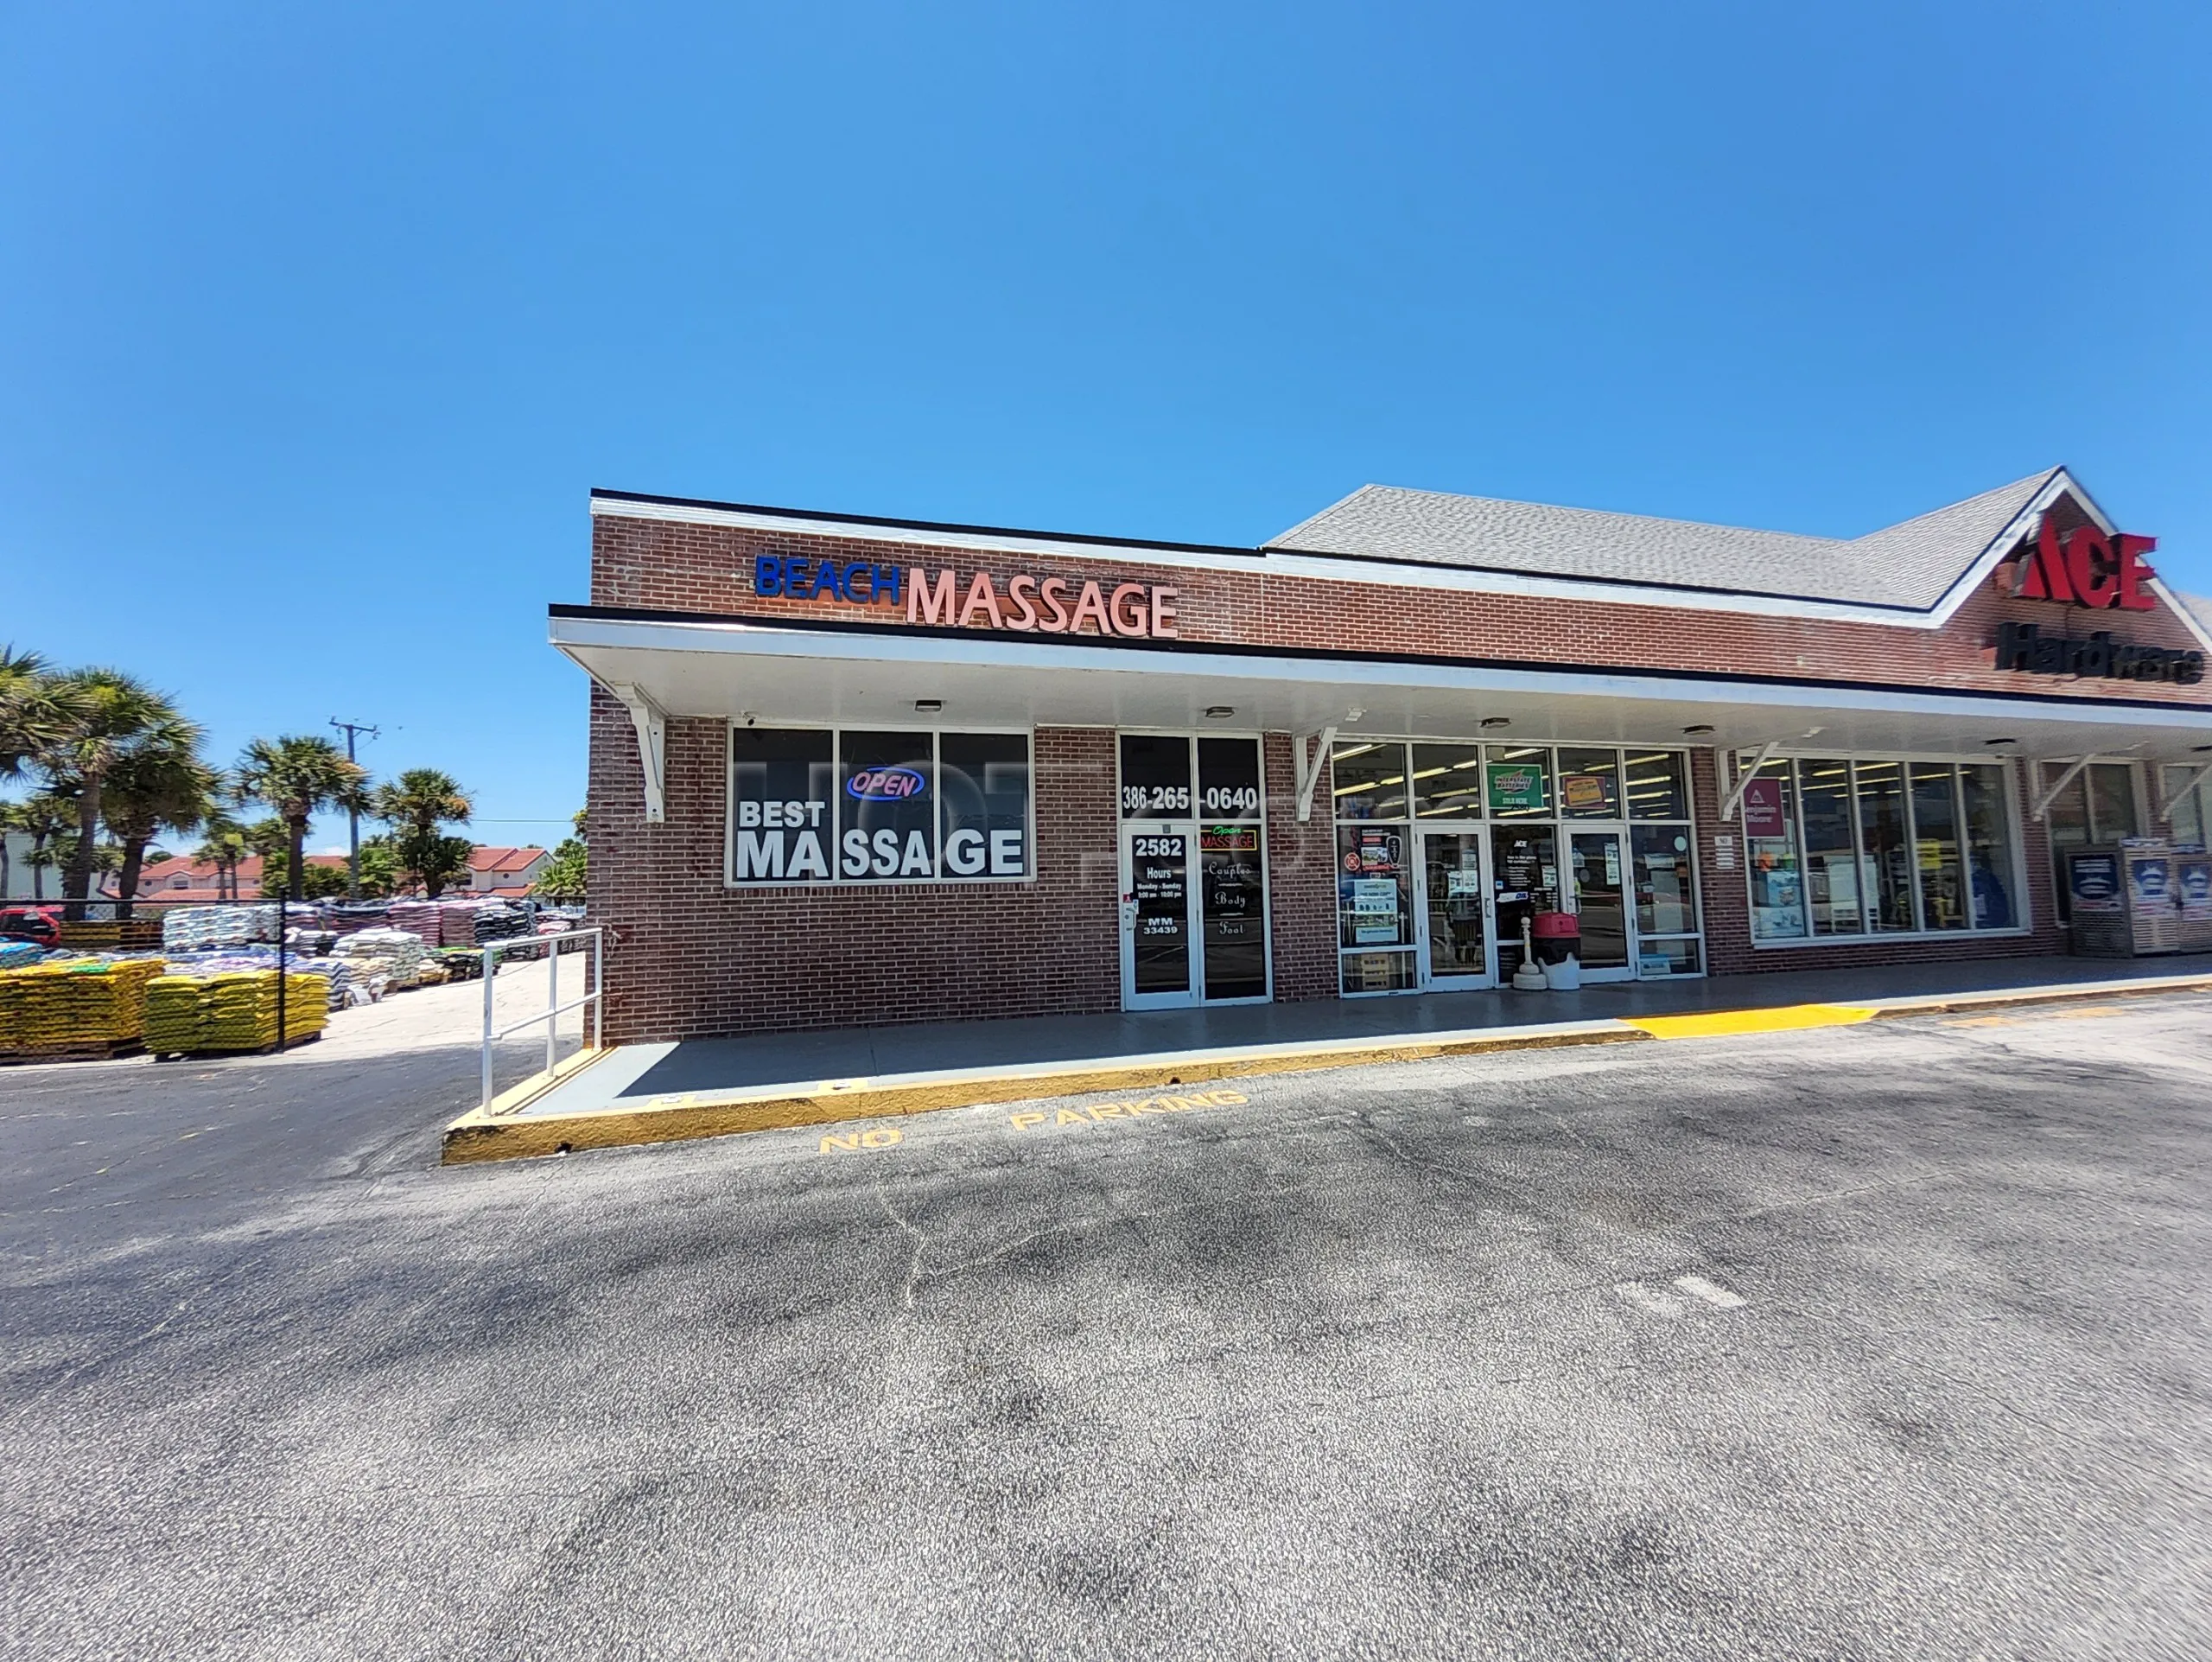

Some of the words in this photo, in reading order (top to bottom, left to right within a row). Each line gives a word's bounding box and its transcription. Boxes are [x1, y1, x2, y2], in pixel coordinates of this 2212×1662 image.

[2013, 512, 2160, 611] ACE
[756, 555, 900, 606] BEACH
[906, 567, 1180, 640] MASSAGE
[1995, 621, 2205, 685] Hardware
[852, 771, 917, 798] OPEN
[739, 801, 825, 828] BEST
[1212, 825, 1242, 835] Open
[1135, 837, 1182, 856] 2582
[1201, 835, 1253, 848] MASSAGE
[737, 829, 1024, 878] MASSAGE
[1147, 867, 1172, 879] Hours
[1209, 861, 1252, 879] Couples
[1137, 882, 1158, 891] Monday
[1215, 892, 1246, 907] Body
[1143, 927, 1179, 935] 33439
[819, 1129, 905, 1154] NO
[1009, 1089, 1249, 1132] PARKING
